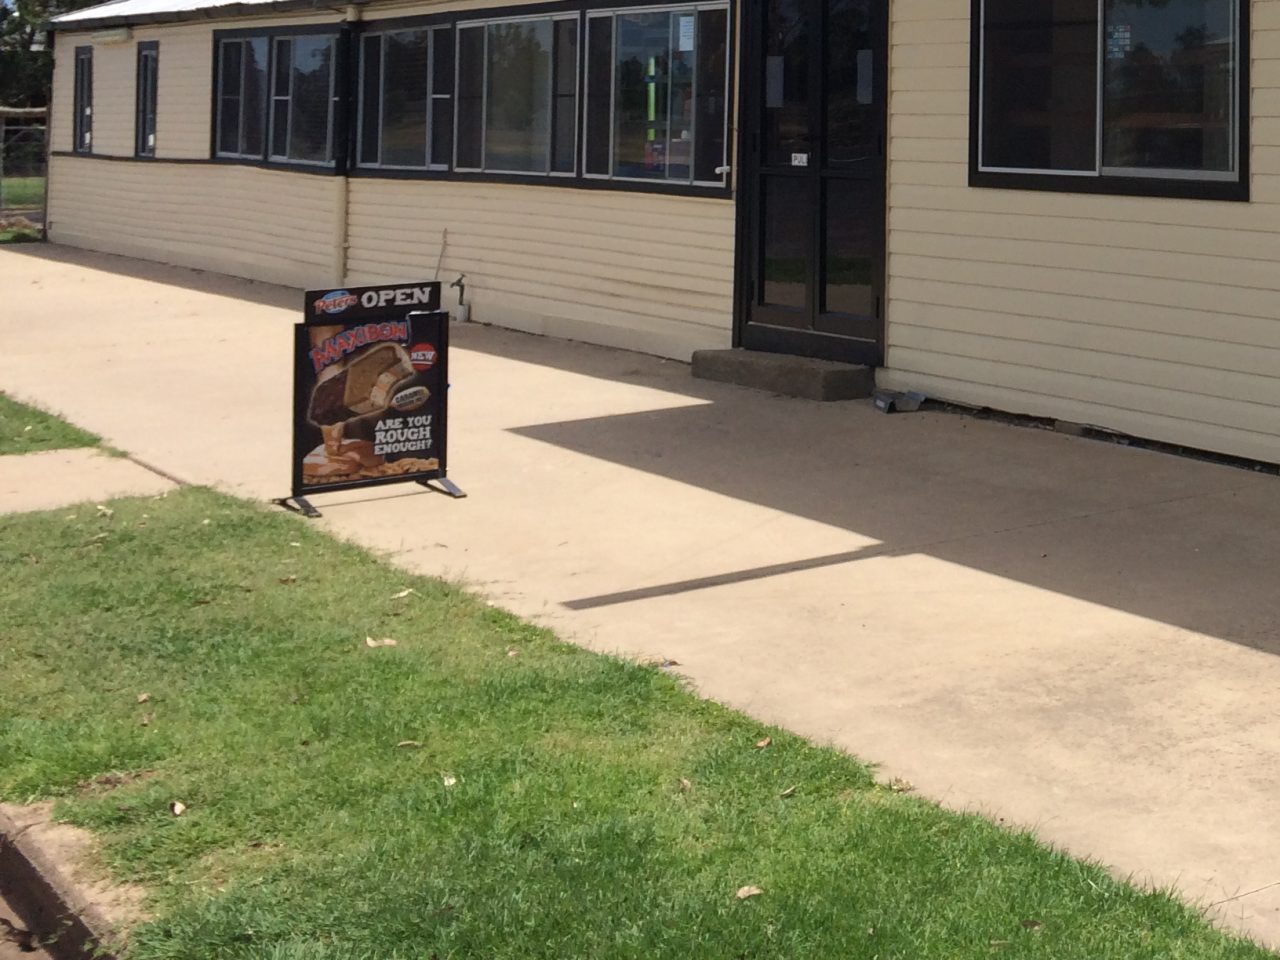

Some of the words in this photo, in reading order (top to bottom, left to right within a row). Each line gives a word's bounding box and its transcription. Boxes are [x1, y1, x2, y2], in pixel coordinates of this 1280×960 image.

[361, 287, 432, 308] OPEN
[410, 351, 435, 361] NEW
[375, 417, 404, 431] ARE
[407, 415, 432, 427] YOU
[375, 426, 431, 444] ROUGH
[374, 439, 433, 455] ENOUGH?
